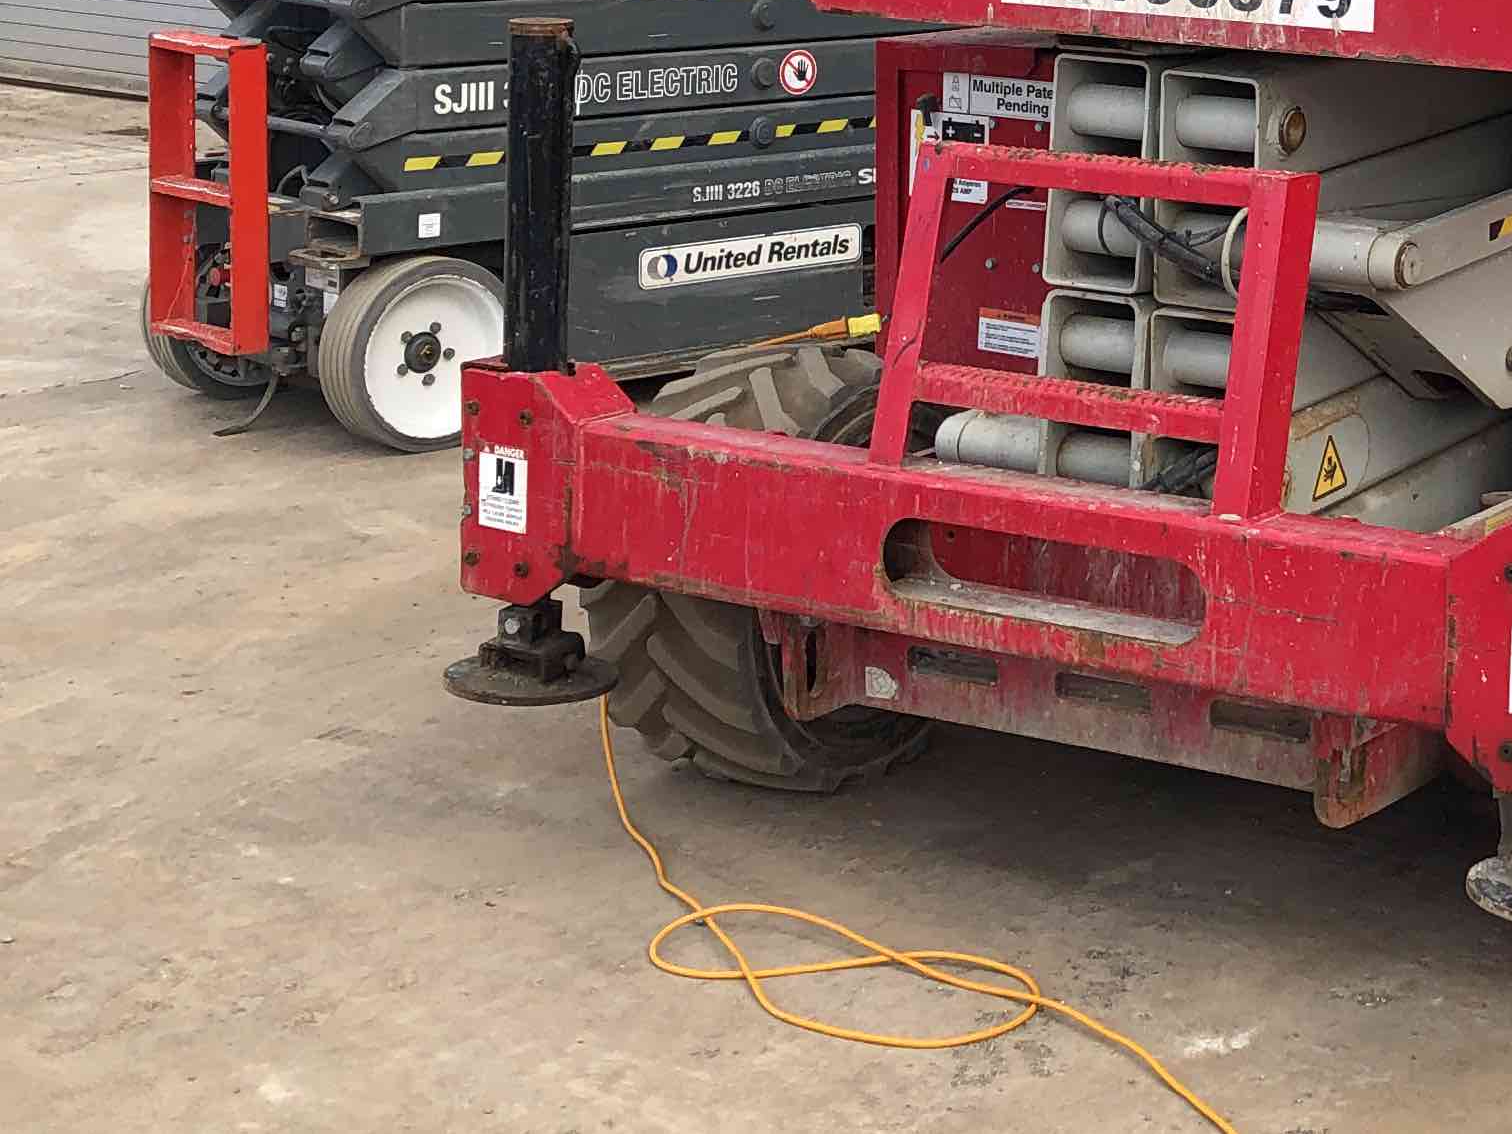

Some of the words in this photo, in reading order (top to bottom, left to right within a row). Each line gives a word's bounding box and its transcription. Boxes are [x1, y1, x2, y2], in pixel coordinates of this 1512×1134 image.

[434, 81, 495, 115] SJIII
[616, 64, 738, 101] ELECTRIC
[973, 79, 1023, 98] Multiple
[1026, 84, 1054, 100] Pate
[997, 98, 1049, 118] Pending
[727, 181, 760, 199] 3226
[684, 243, 764, 275] United
[767, 233, 850, 263] Rentals
